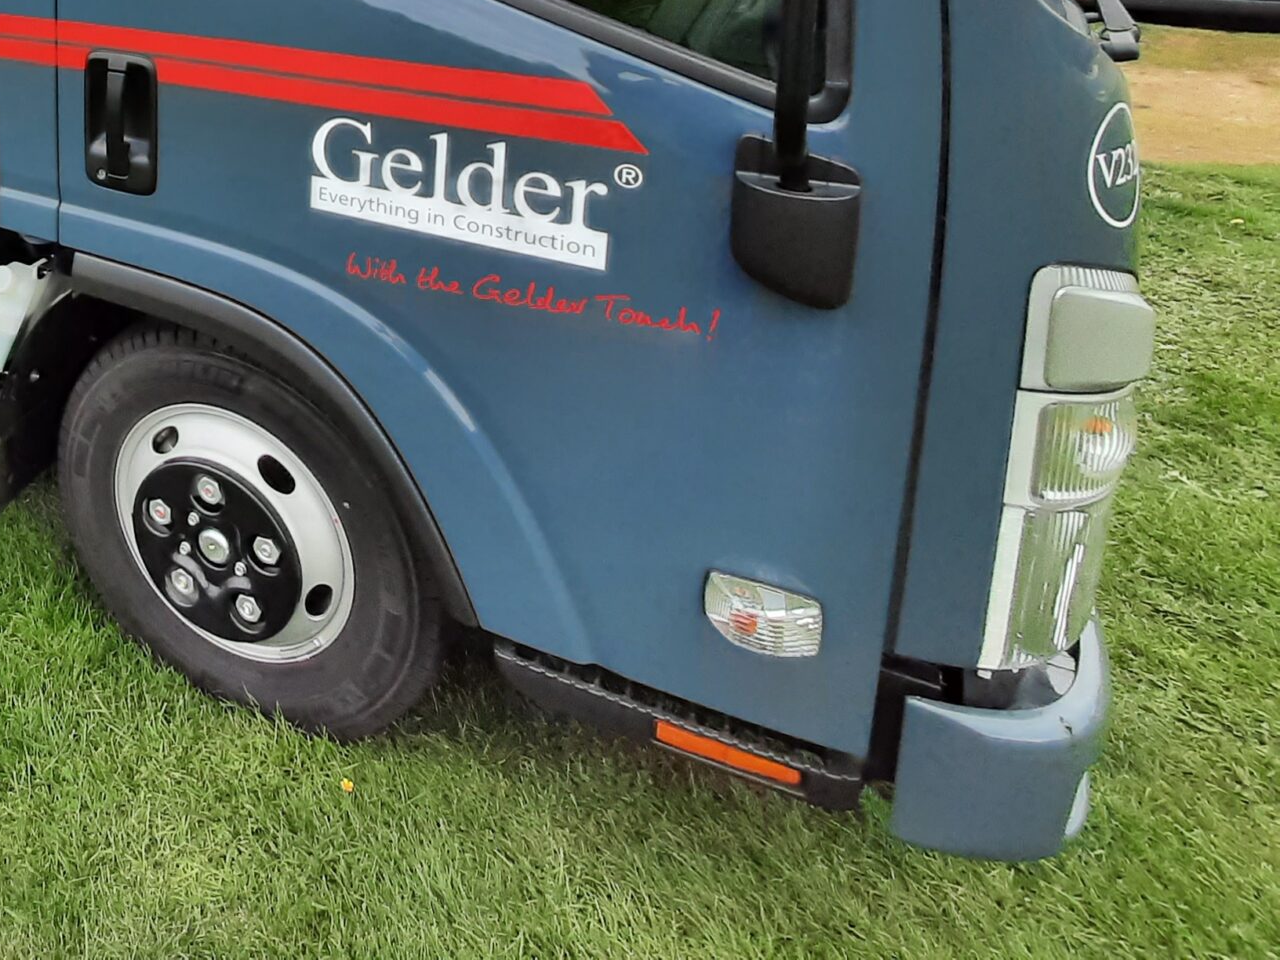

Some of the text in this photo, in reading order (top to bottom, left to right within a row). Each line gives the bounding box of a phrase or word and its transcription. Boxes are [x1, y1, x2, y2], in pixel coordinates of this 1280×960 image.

[311, 117, 609, 232] Gelder
[318, 186, 596, 258] Everything in Construction
[346, 252, 407, 286] With
[417, 267, 464, 296] the
[472, 274, 586, 315] Gelder
